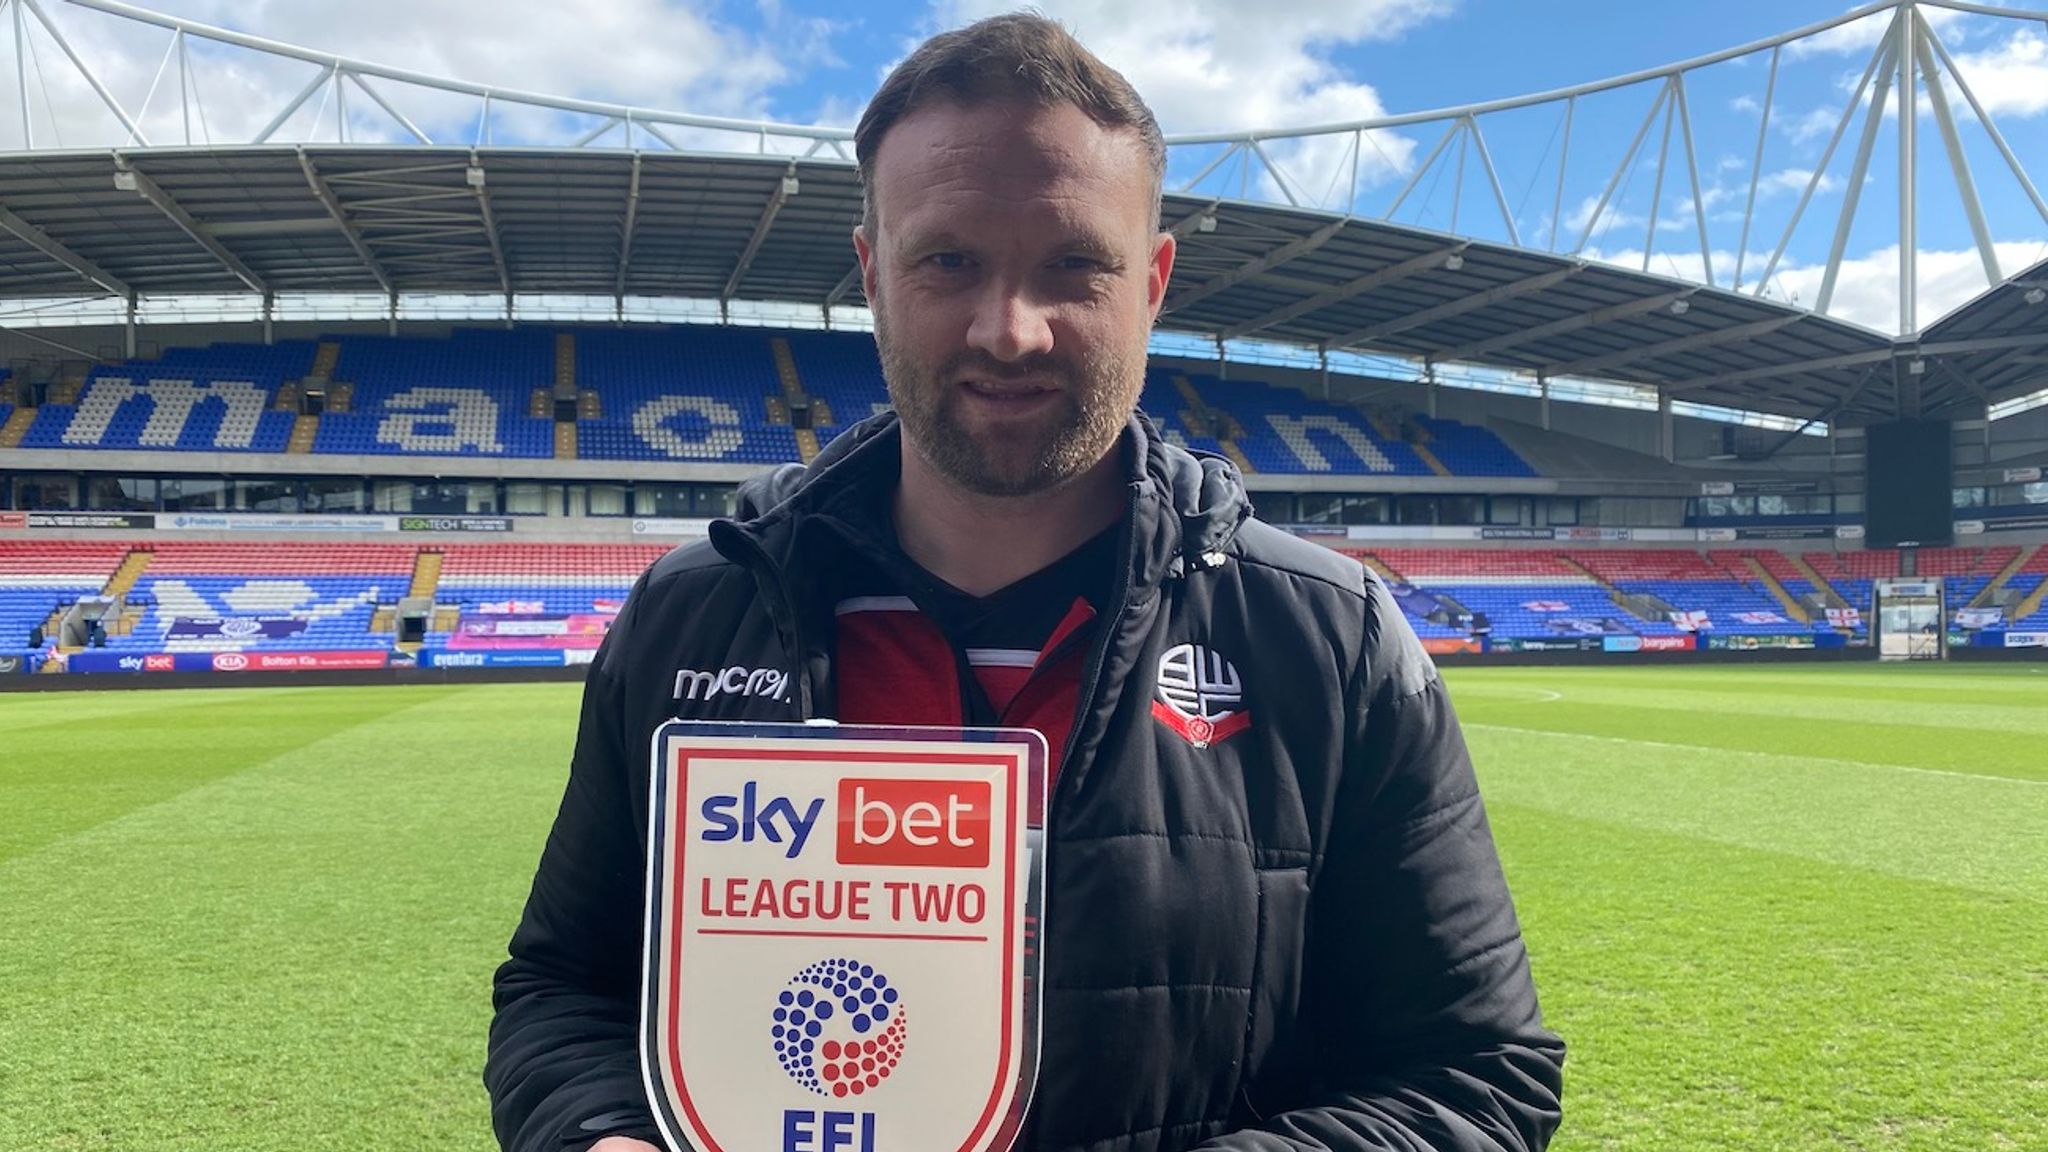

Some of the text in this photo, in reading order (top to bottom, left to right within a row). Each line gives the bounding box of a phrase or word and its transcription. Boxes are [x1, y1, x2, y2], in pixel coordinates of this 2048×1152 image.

[1643, 637, 1685, 650] bargains
[119, 656, 172, 669] sky bet
[219, 656, 242, 667] KIA
[262, 655, 297, 666] Bolton
[299, 655, 316, 666] Kia
[433, 652, 484, 667] eventura
[701, 781, 975, 858] sky bet
[701, 877, 986, 924] LEAGUE TWO
